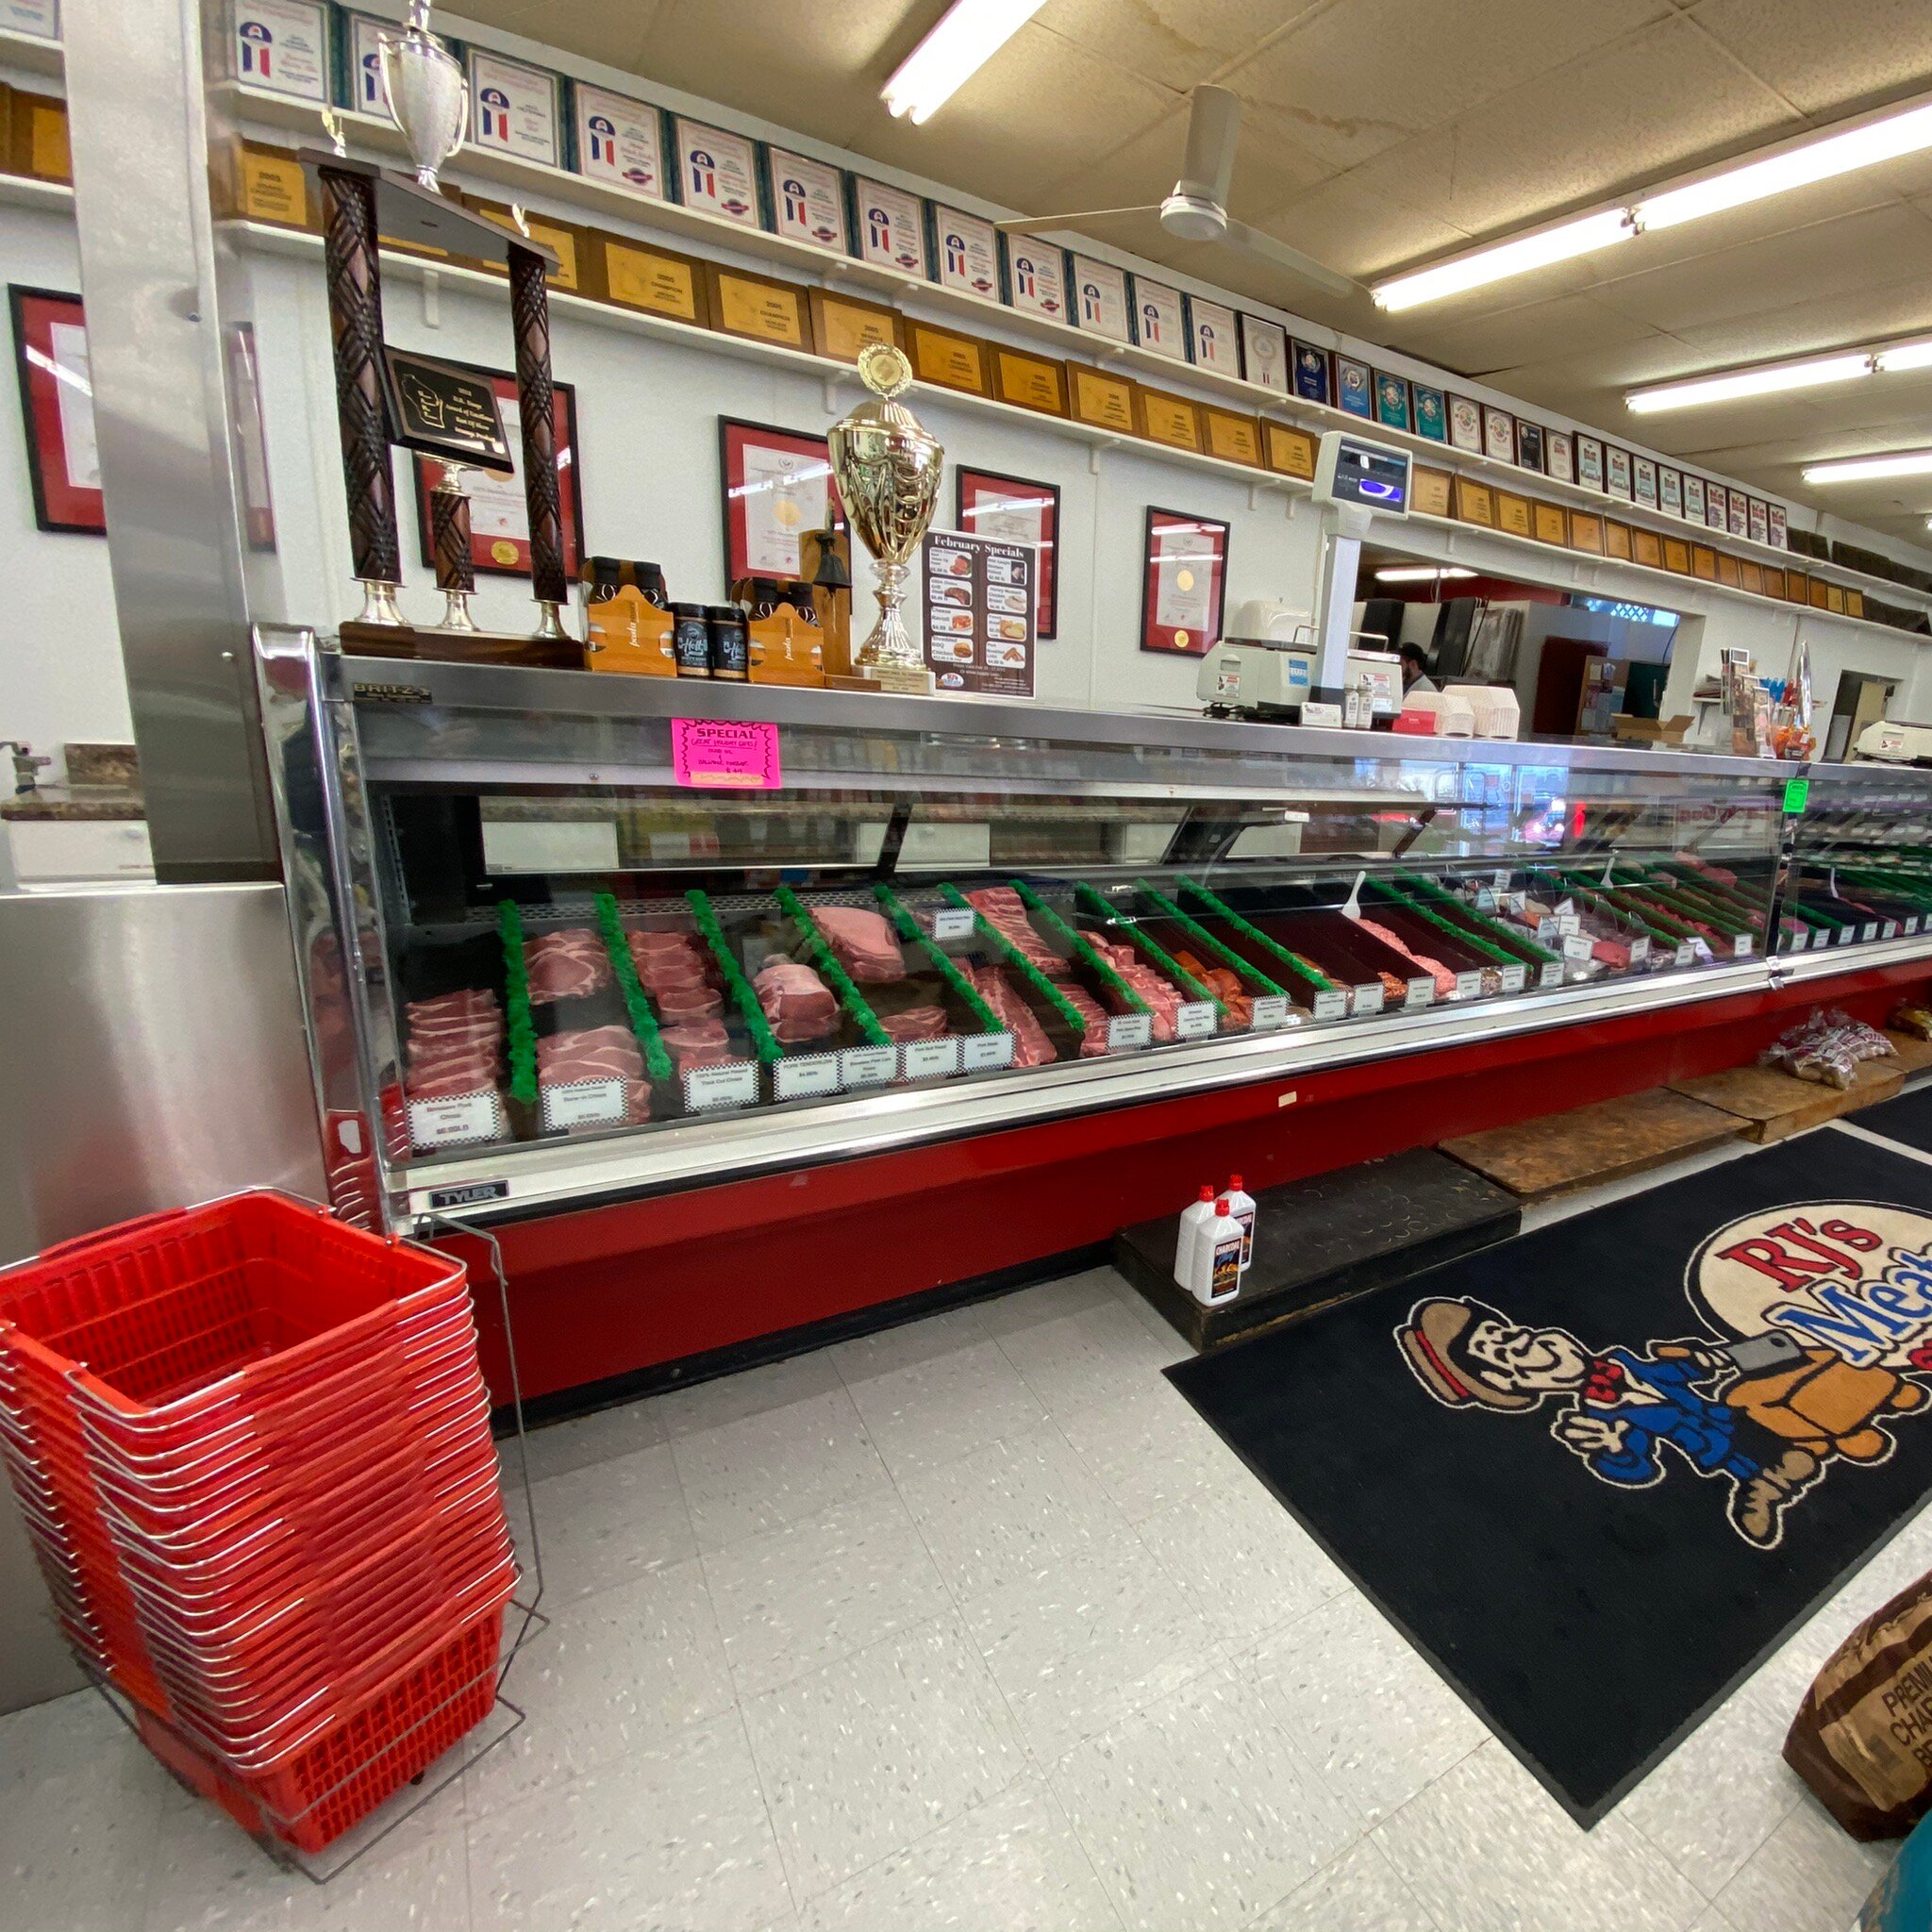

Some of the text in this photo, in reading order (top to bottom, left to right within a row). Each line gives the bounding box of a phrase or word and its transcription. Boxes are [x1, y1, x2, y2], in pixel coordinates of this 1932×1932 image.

[934, 535, 1024, 558] February Specials
[696, 727, 757, 740] SPECIAL
[800, 1058, 833, 1067] TENDERLOIN
[437, 1185, 498, 1205] TYLER
[1215, 1240, 1240, 1256] CHARCOAL
[1713, 1217, 1884, 1293] RJ's
